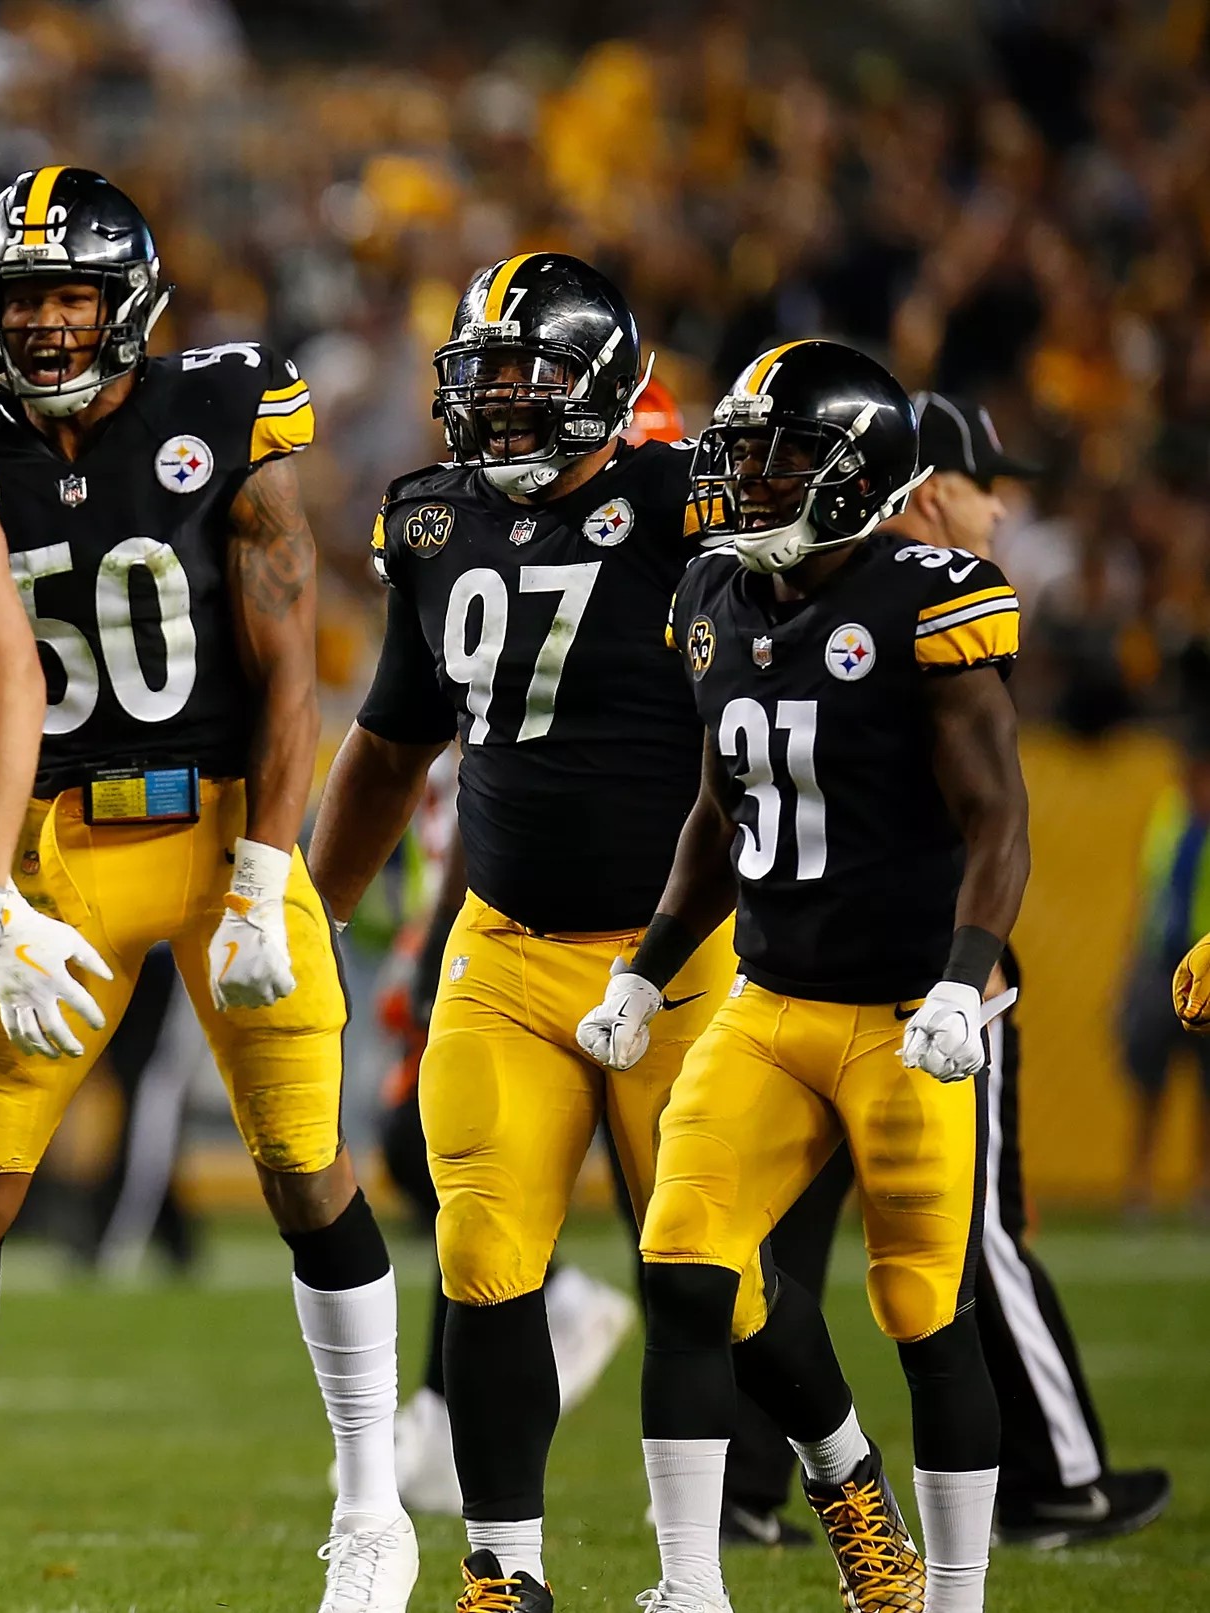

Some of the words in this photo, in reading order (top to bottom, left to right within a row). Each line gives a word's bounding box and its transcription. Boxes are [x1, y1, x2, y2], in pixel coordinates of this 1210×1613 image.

[473, 324, 503, 336] Steelers
[425, 510, 439, 521] M
[412, 524, 423, 537] D
[434, 523, 444, 536] R
[8, 536, 197, 735] 50
[444, 561, 603, 746] 97
[718, 697, 828, 881] 31
[242, 857, 256, 870] BE
